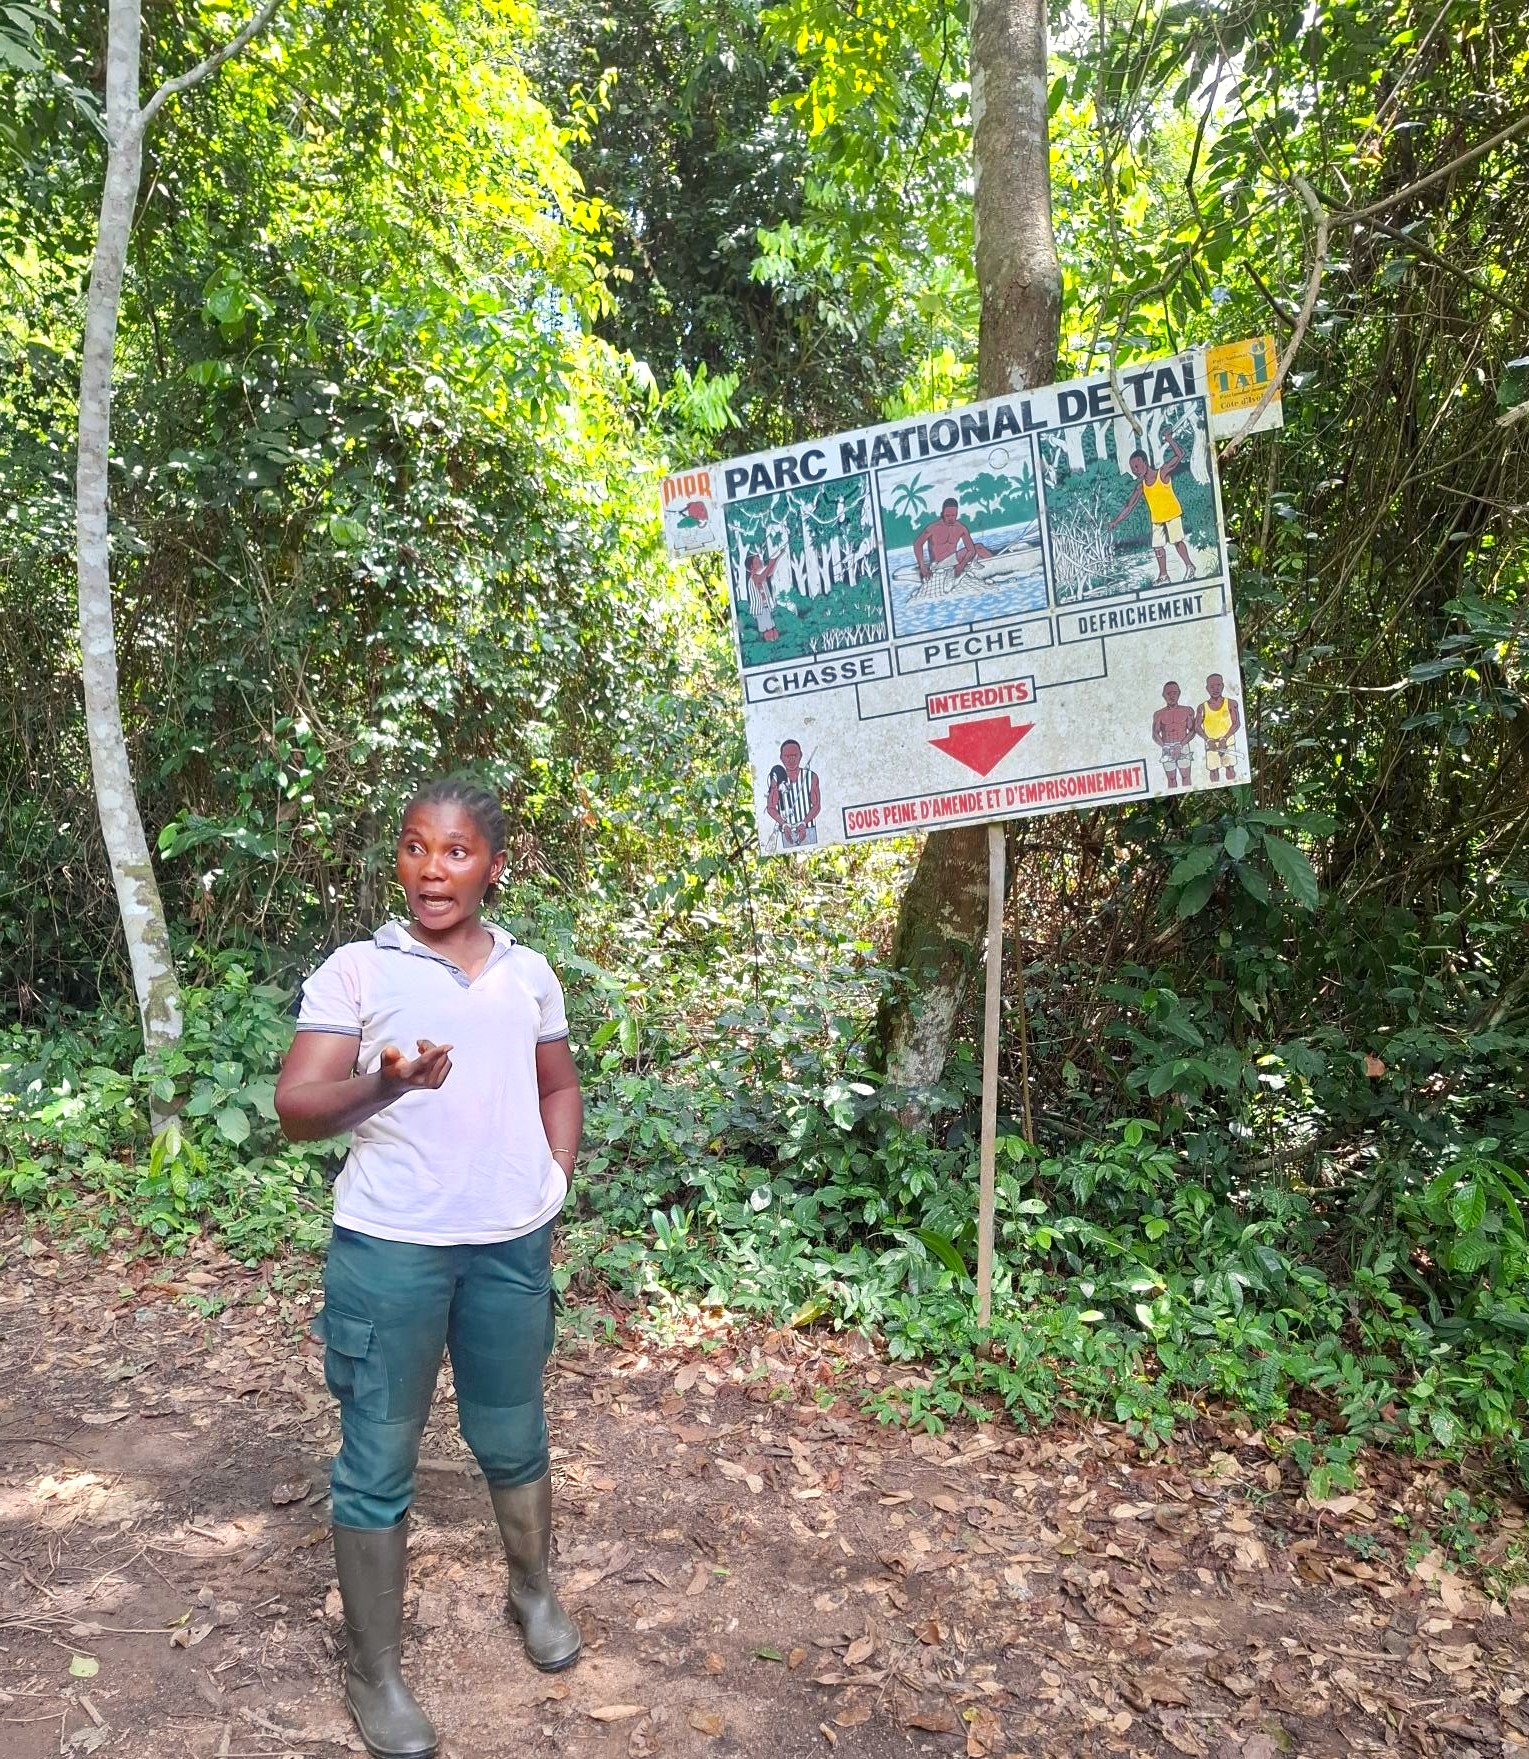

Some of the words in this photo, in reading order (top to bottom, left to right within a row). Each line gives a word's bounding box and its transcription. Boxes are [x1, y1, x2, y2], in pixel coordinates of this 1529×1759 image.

[725, 449, 828, 500] PARC
[839, 400, 1048, 474] NATIONAL
[1056, 381, 1115, 425] DE
[1078, 595, 1203, 635] DEFRICHEMENT
[924, 628, 1024, 664] PECHE
[762, 658, 876, 695] CHASSE
[929, 682, 1029, 715] INTERDITS
[848, 808, 880, 831] SOUS
[883, 802, 918, 825] PEINE
[919, 791, 984, 820] D'AMENDE
[986, 789, 1001, 809] ET
[1005, 766, 1141, 807] D'EMPRISONNEMENT
